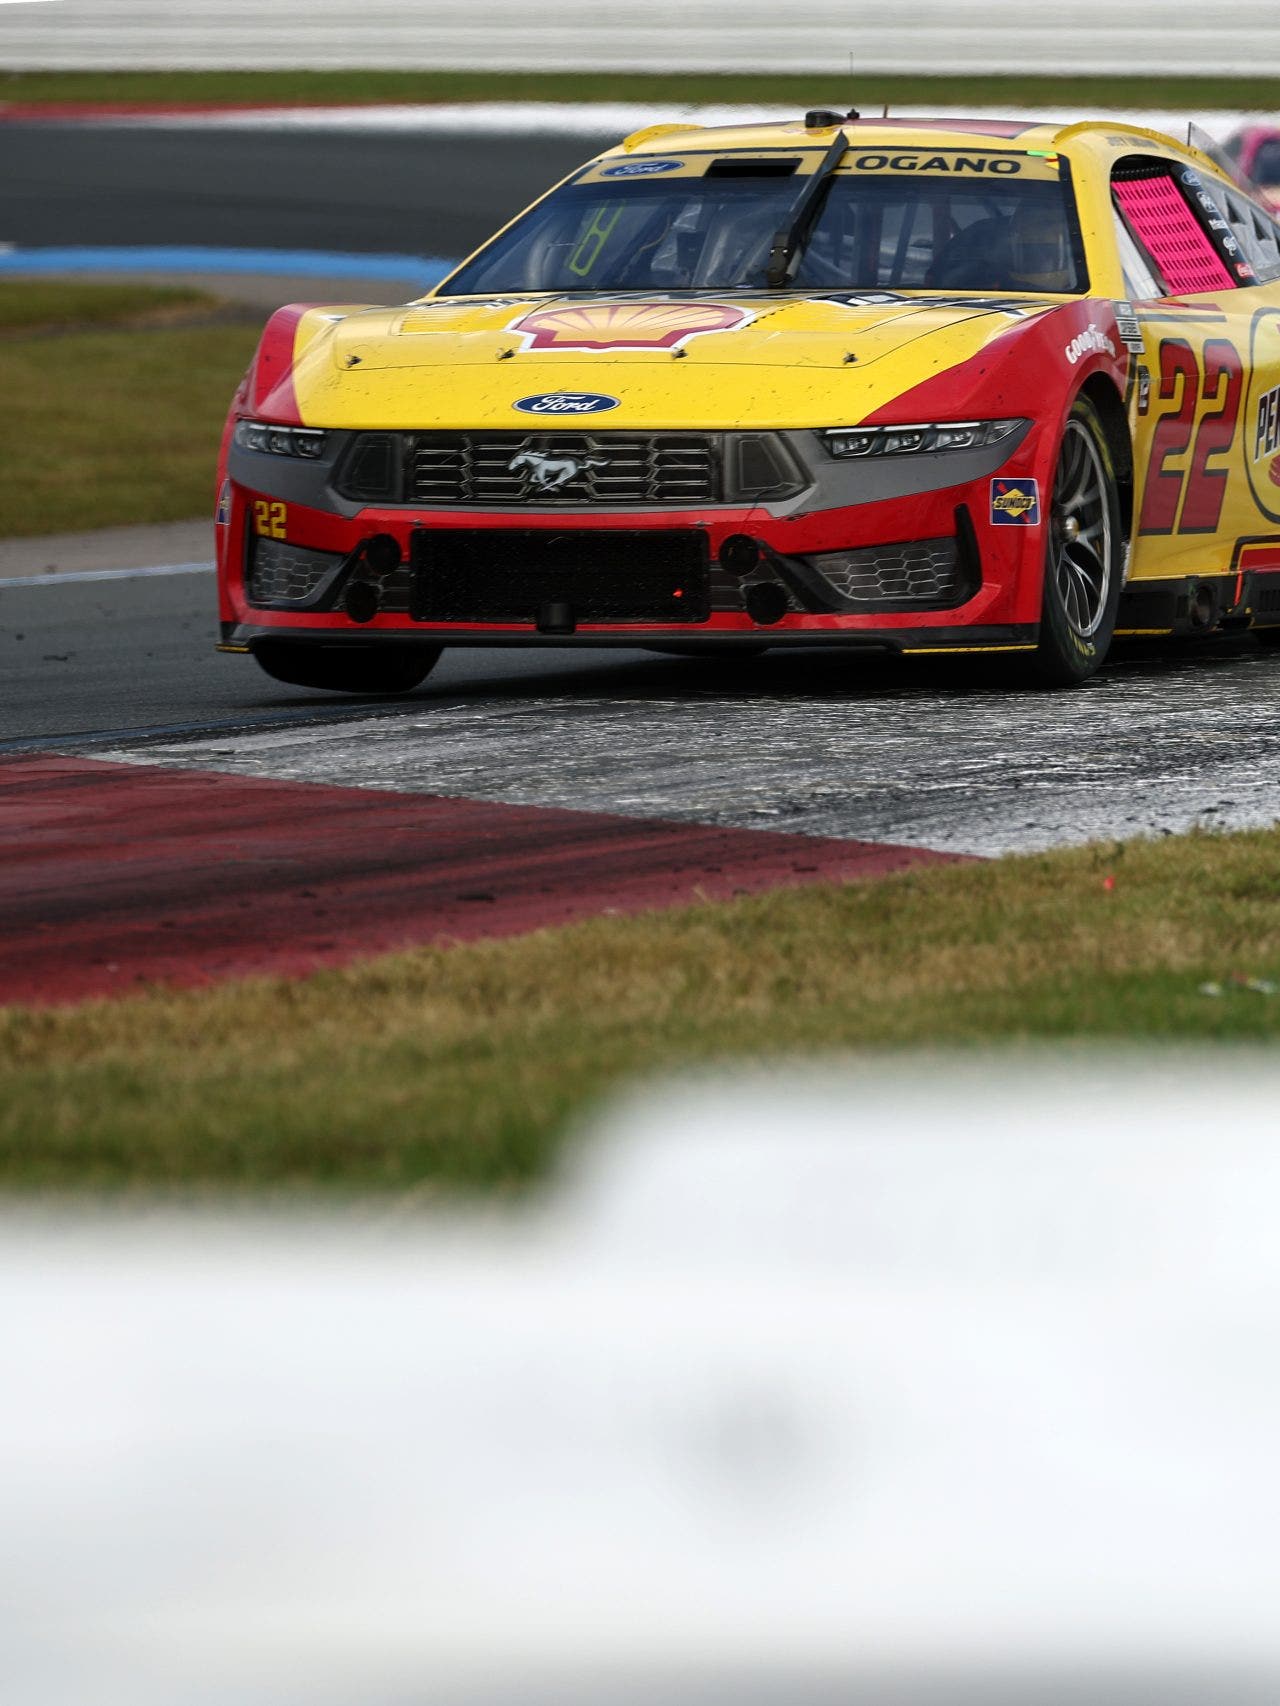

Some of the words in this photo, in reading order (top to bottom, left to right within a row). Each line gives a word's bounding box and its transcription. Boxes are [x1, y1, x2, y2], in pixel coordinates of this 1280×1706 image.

[531, 395, 600, 411] Ford
[1138, 338, 1244, 537] 22
[994, 497, 1033, 509] SUNOCO
[254, 500, 287, 539] 22
